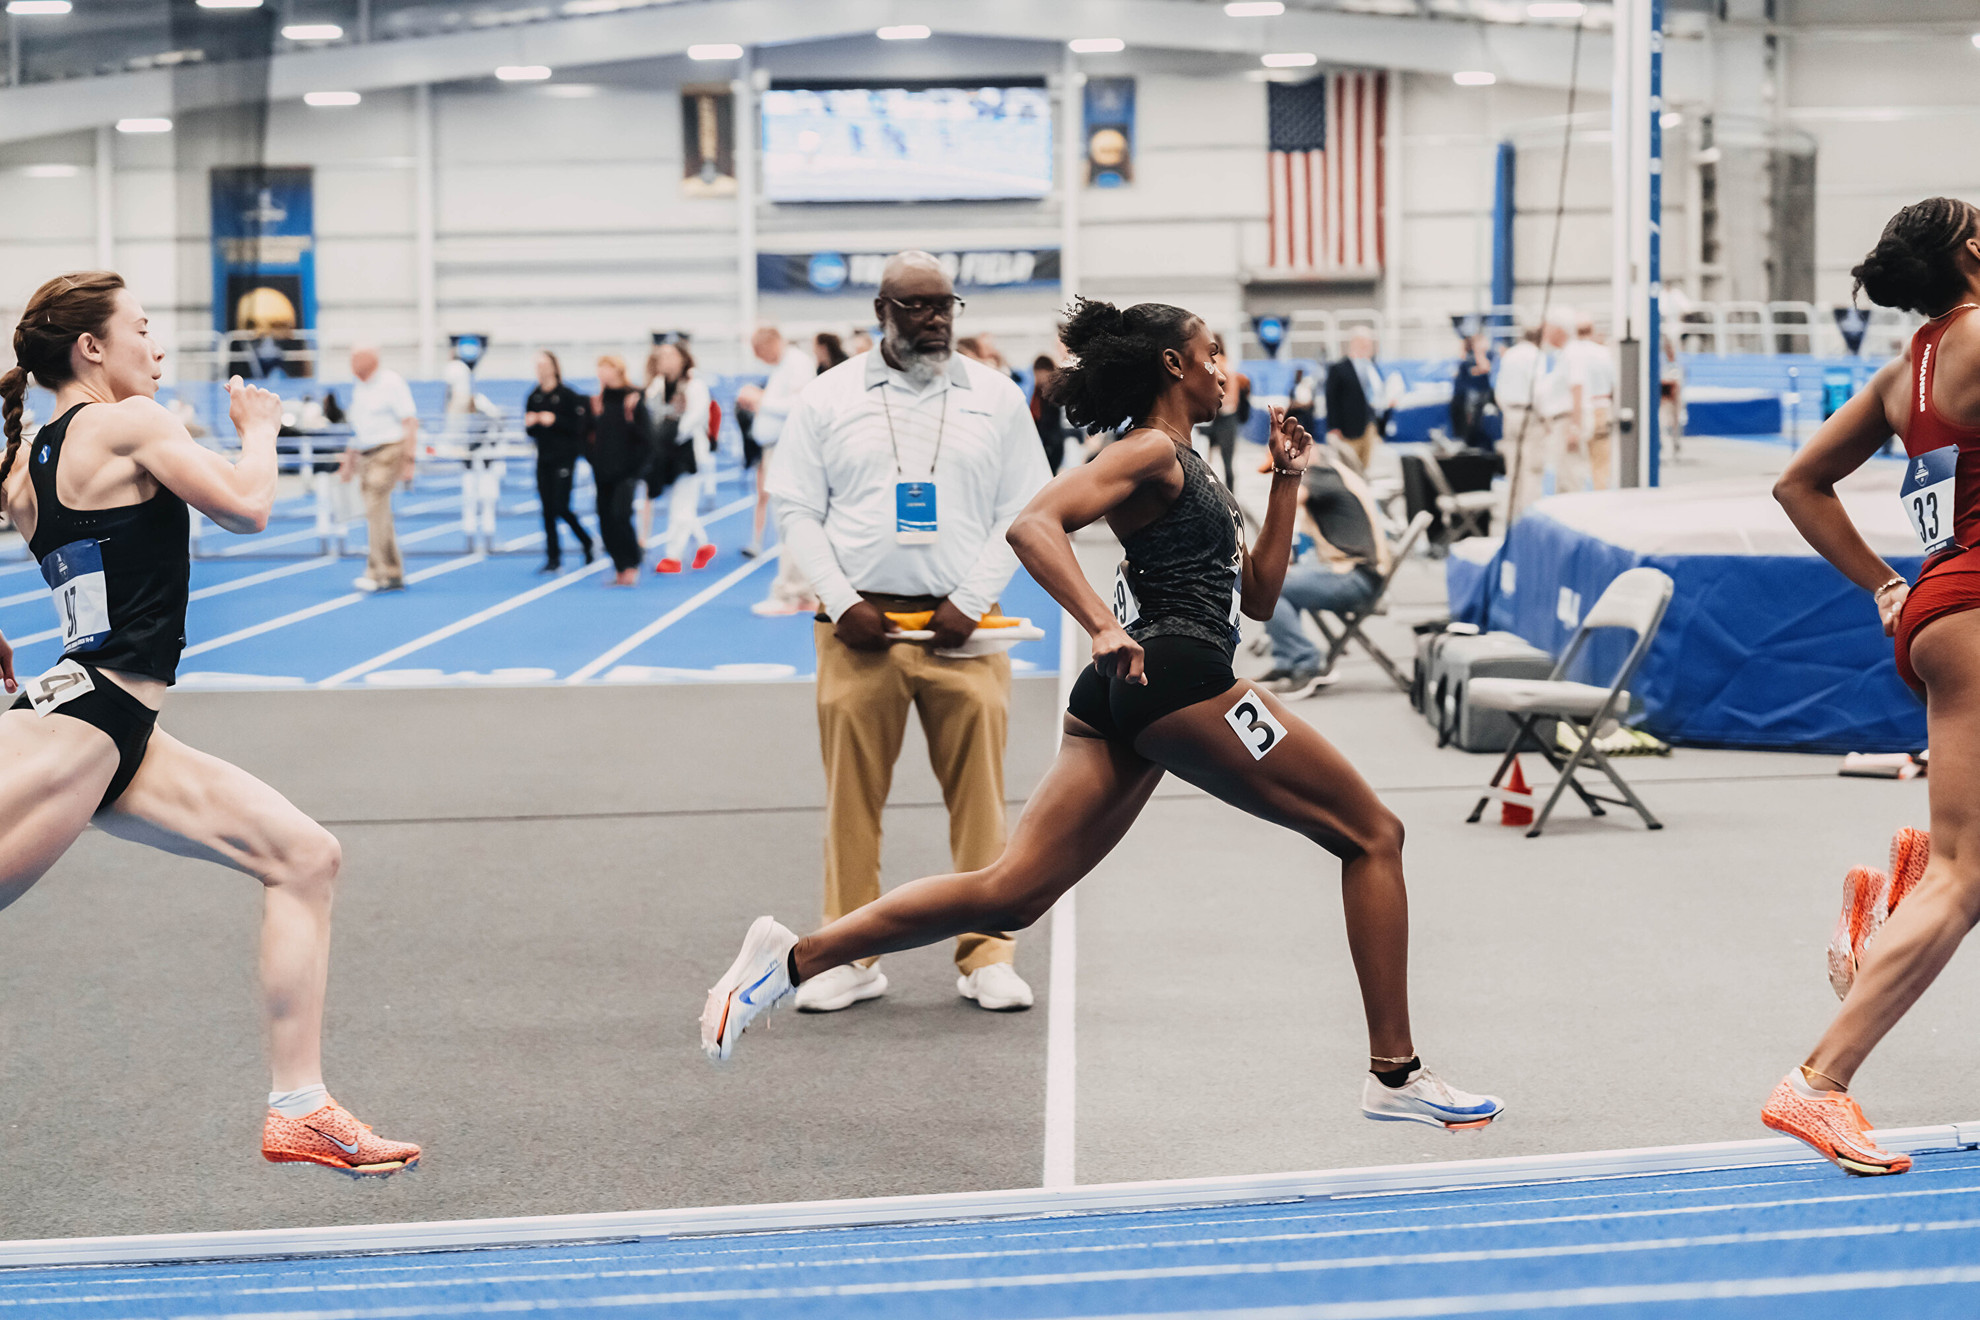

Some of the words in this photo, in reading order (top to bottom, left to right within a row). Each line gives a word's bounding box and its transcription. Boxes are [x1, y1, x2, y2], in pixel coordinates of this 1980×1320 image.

[1919, 343, 1932, 412] ARKANSAS
[1914, 492, 1939, 544] 33
[34, 672, 86, 706] 4
[1234, 701, 1275, 753] 3
